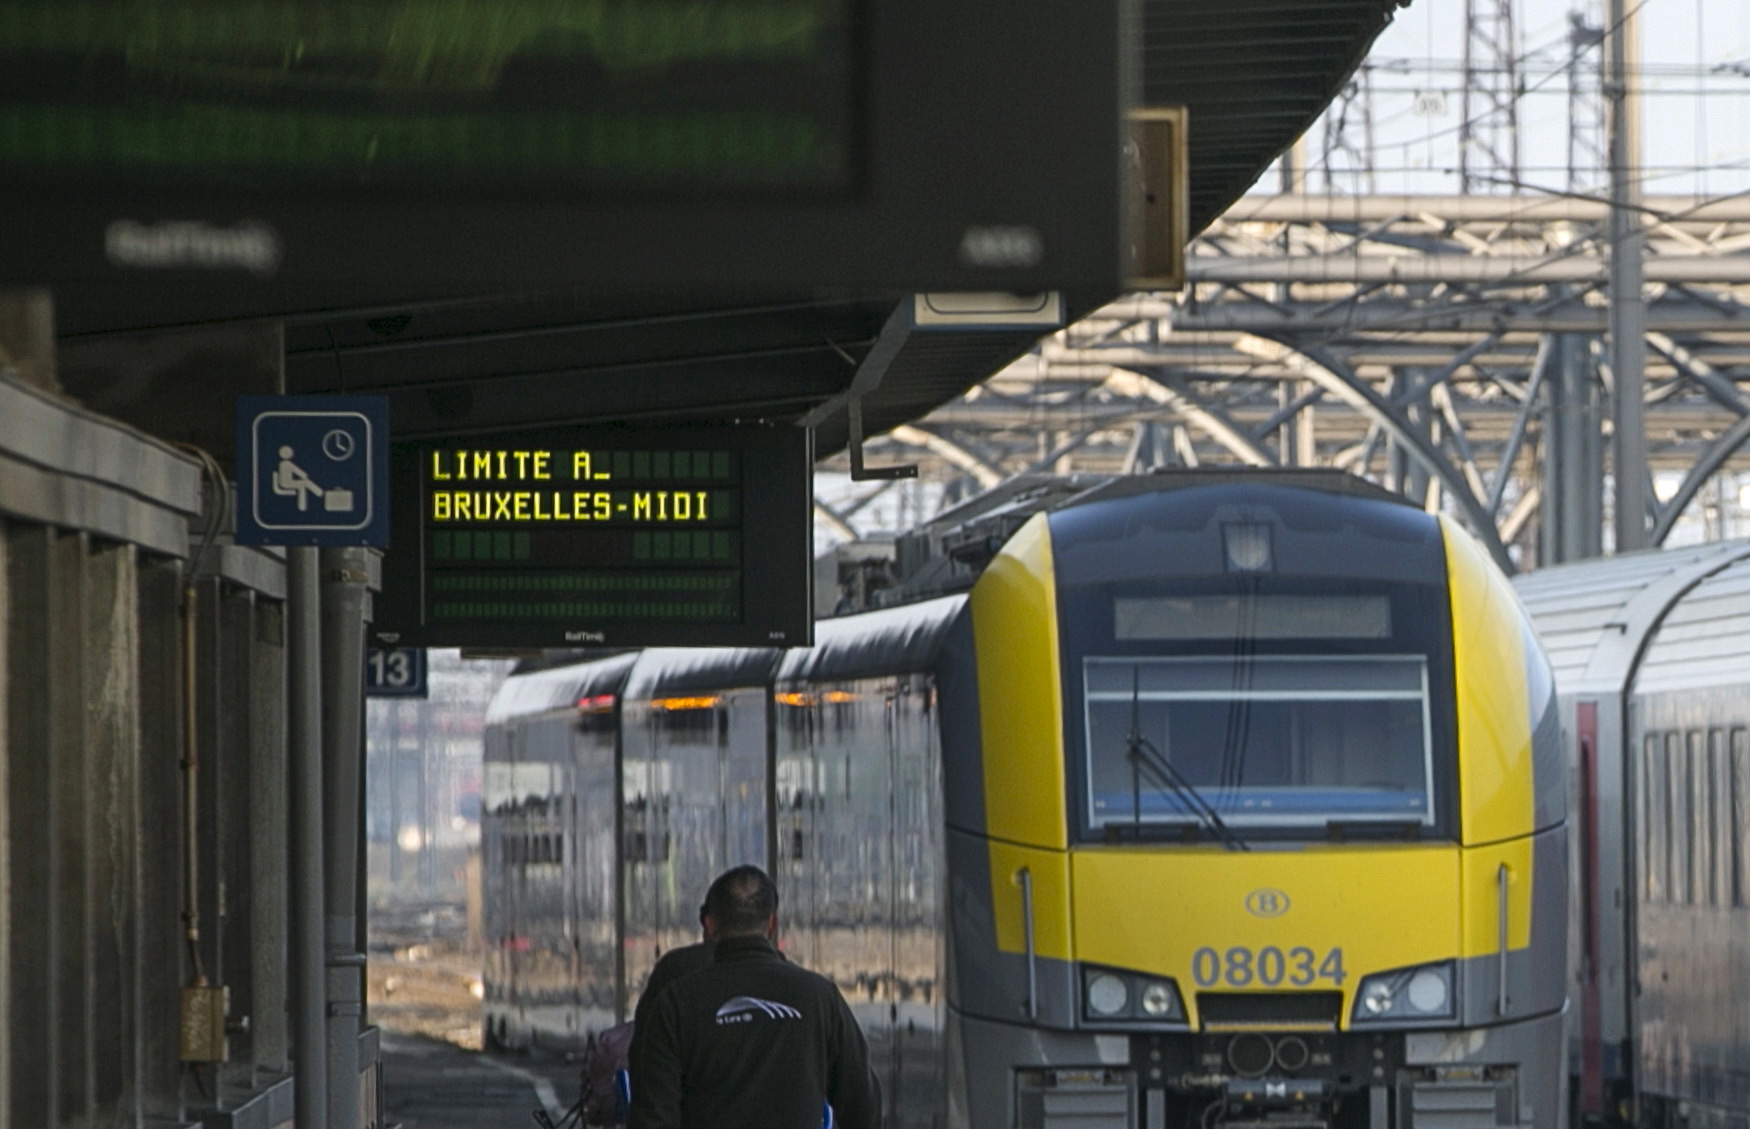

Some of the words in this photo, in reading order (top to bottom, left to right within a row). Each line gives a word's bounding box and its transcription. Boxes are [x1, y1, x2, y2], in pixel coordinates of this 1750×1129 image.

[434, 451, 550, 480] LIMITE
[434, 492, 707, 520] BRUXELLES-MIDI
[369, 651, 409, 686] 13
[1192, 946, 1346, 987] 08034
